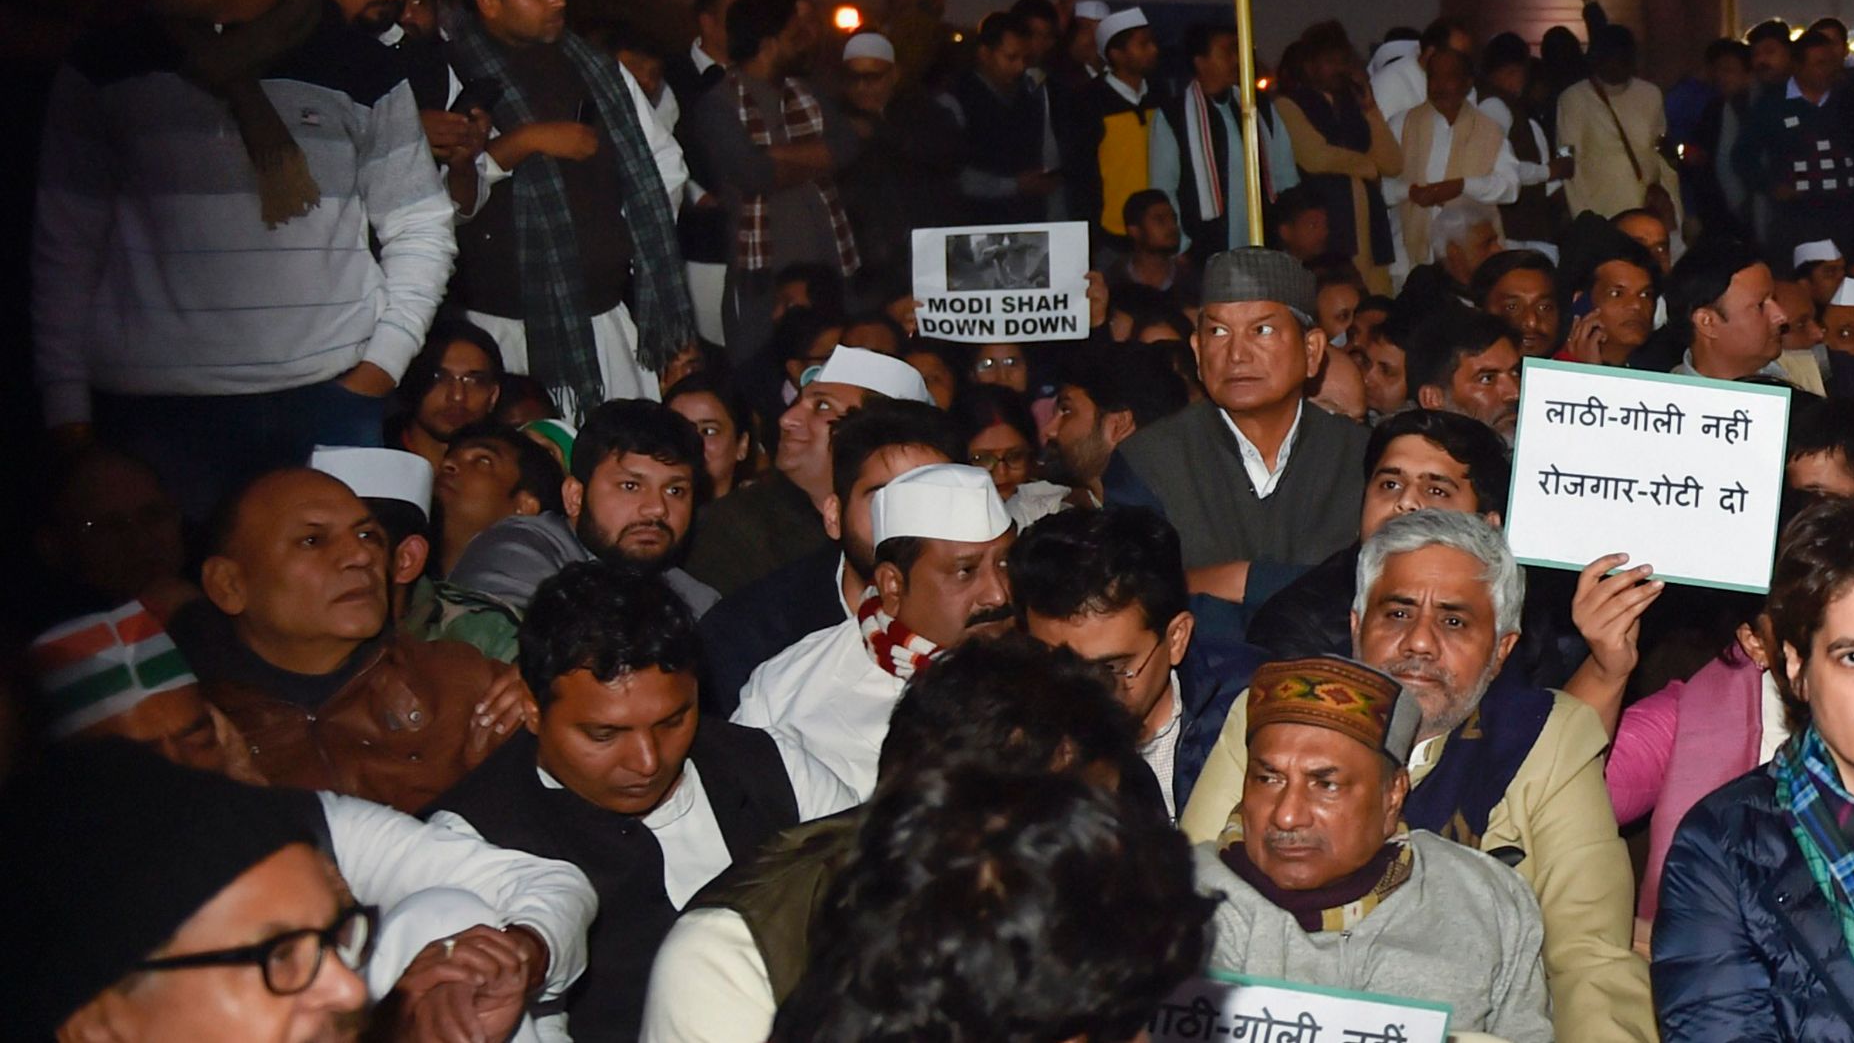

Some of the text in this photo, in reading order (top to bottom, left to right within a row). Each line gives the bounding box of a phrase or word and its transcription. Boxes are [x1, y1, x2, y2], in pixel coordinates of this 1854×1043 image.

[928, 294, 1069, 314] MODI SHAH
[922, 315, 1077, 336] DOWN DOWN
[1545, 395, 1753, 445] लाठी-गोली नहीं
[1538, 463, 1749, 515] रोजगार-रोटी दो
